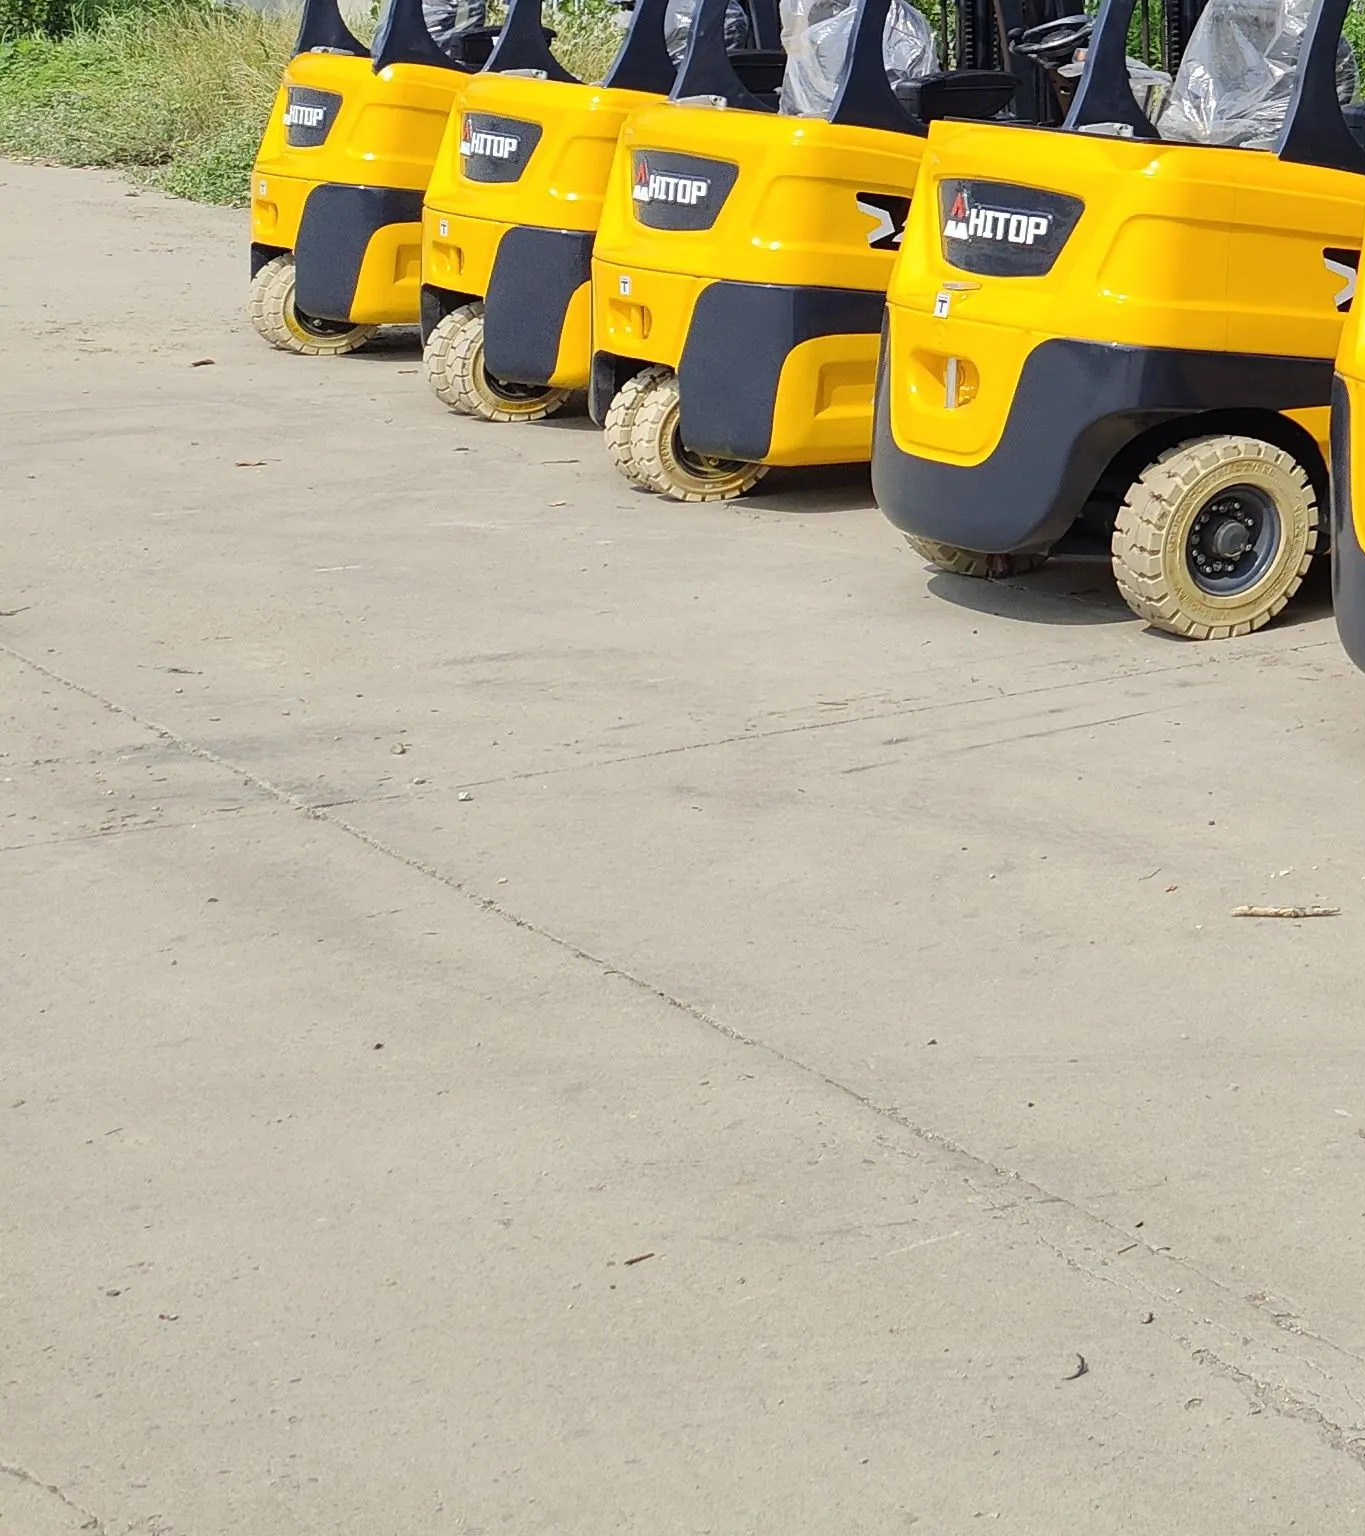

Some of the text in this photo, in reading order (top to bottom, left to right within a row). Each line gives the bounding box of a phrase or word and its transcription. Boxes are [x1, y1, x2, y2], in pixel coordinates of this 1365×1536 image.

[289, 104, 324, 126] HITOP
[470, 132, 518, 159] HITOP
[648, 174, 708, 205] HITOP
[968, 207, 1049, 245] HITOP
[620, 280, 629, 292] T
[938, 298, 948, 314] T
